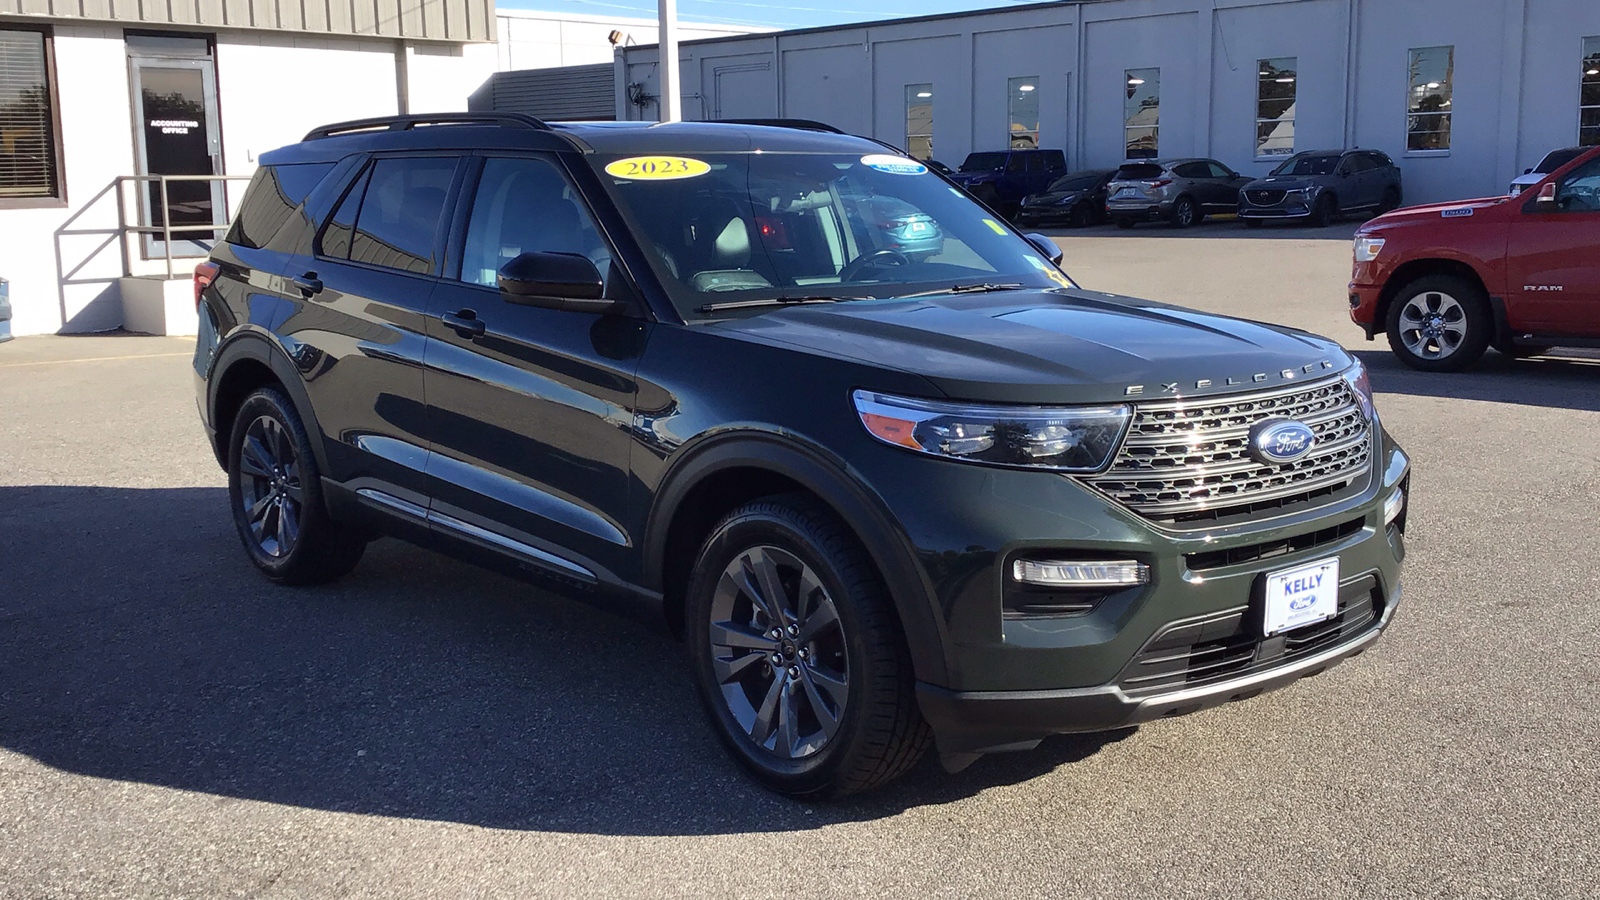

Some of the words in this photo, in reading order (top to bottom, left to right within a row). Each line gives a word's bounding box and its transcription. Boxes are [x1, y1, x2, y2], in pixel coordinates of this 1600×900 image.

[150, 120, 199, 128] ACCOUNTING
[625, 160, 689, 176] 2023
[1124, 359, 1333, 396] EXPLORER
[1276, 431, 1305, 454] Ford
[1284, 573, 1323, 596] KELLY
